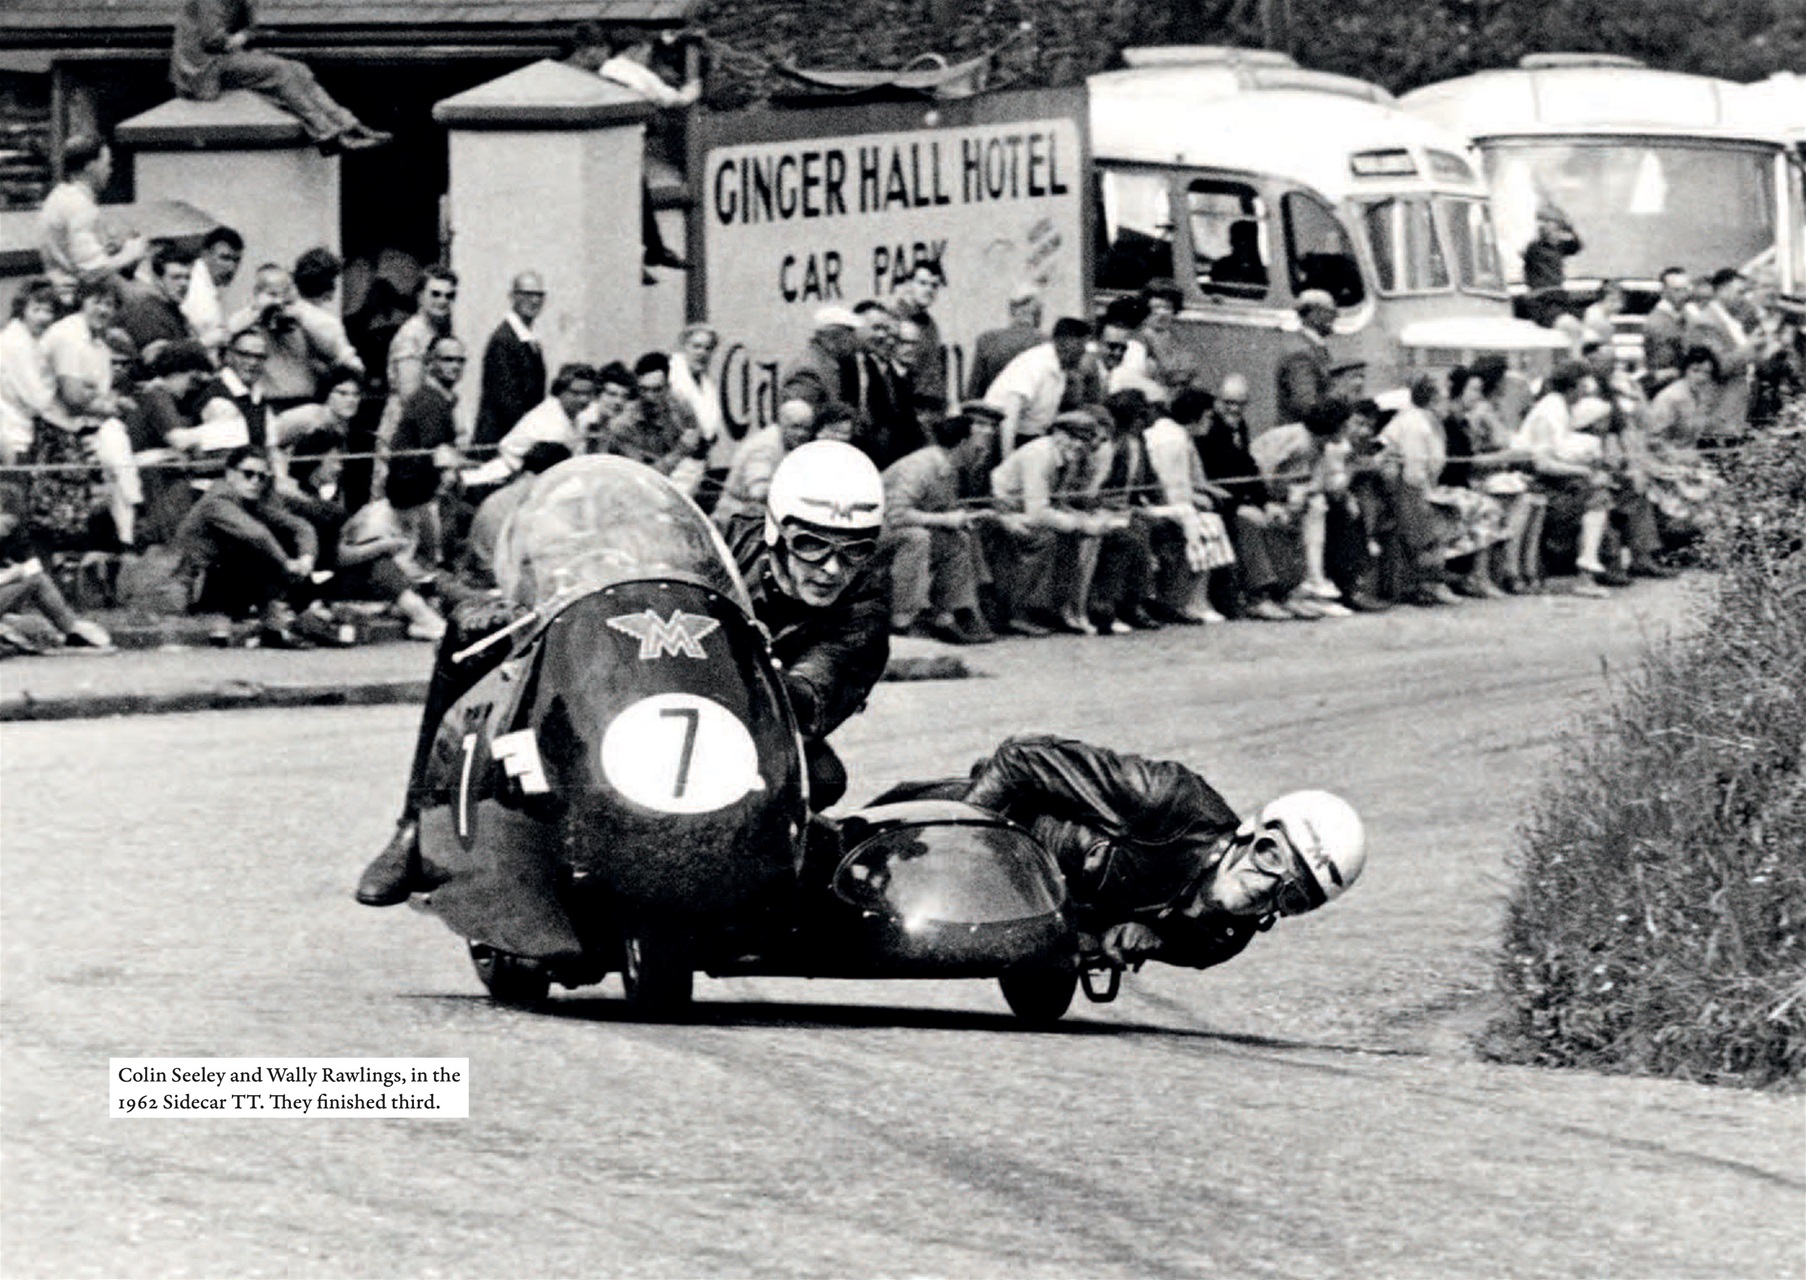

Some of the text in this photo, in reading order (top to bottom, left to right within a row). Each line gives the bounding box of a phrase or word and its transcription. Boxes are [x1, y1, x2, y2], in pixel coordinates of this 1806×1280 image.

[714, 133, 1069, 226] GINGER HALL HOTEL
[779, 249, 842, 303] CAR
[659, 707, 699, 799] 7
